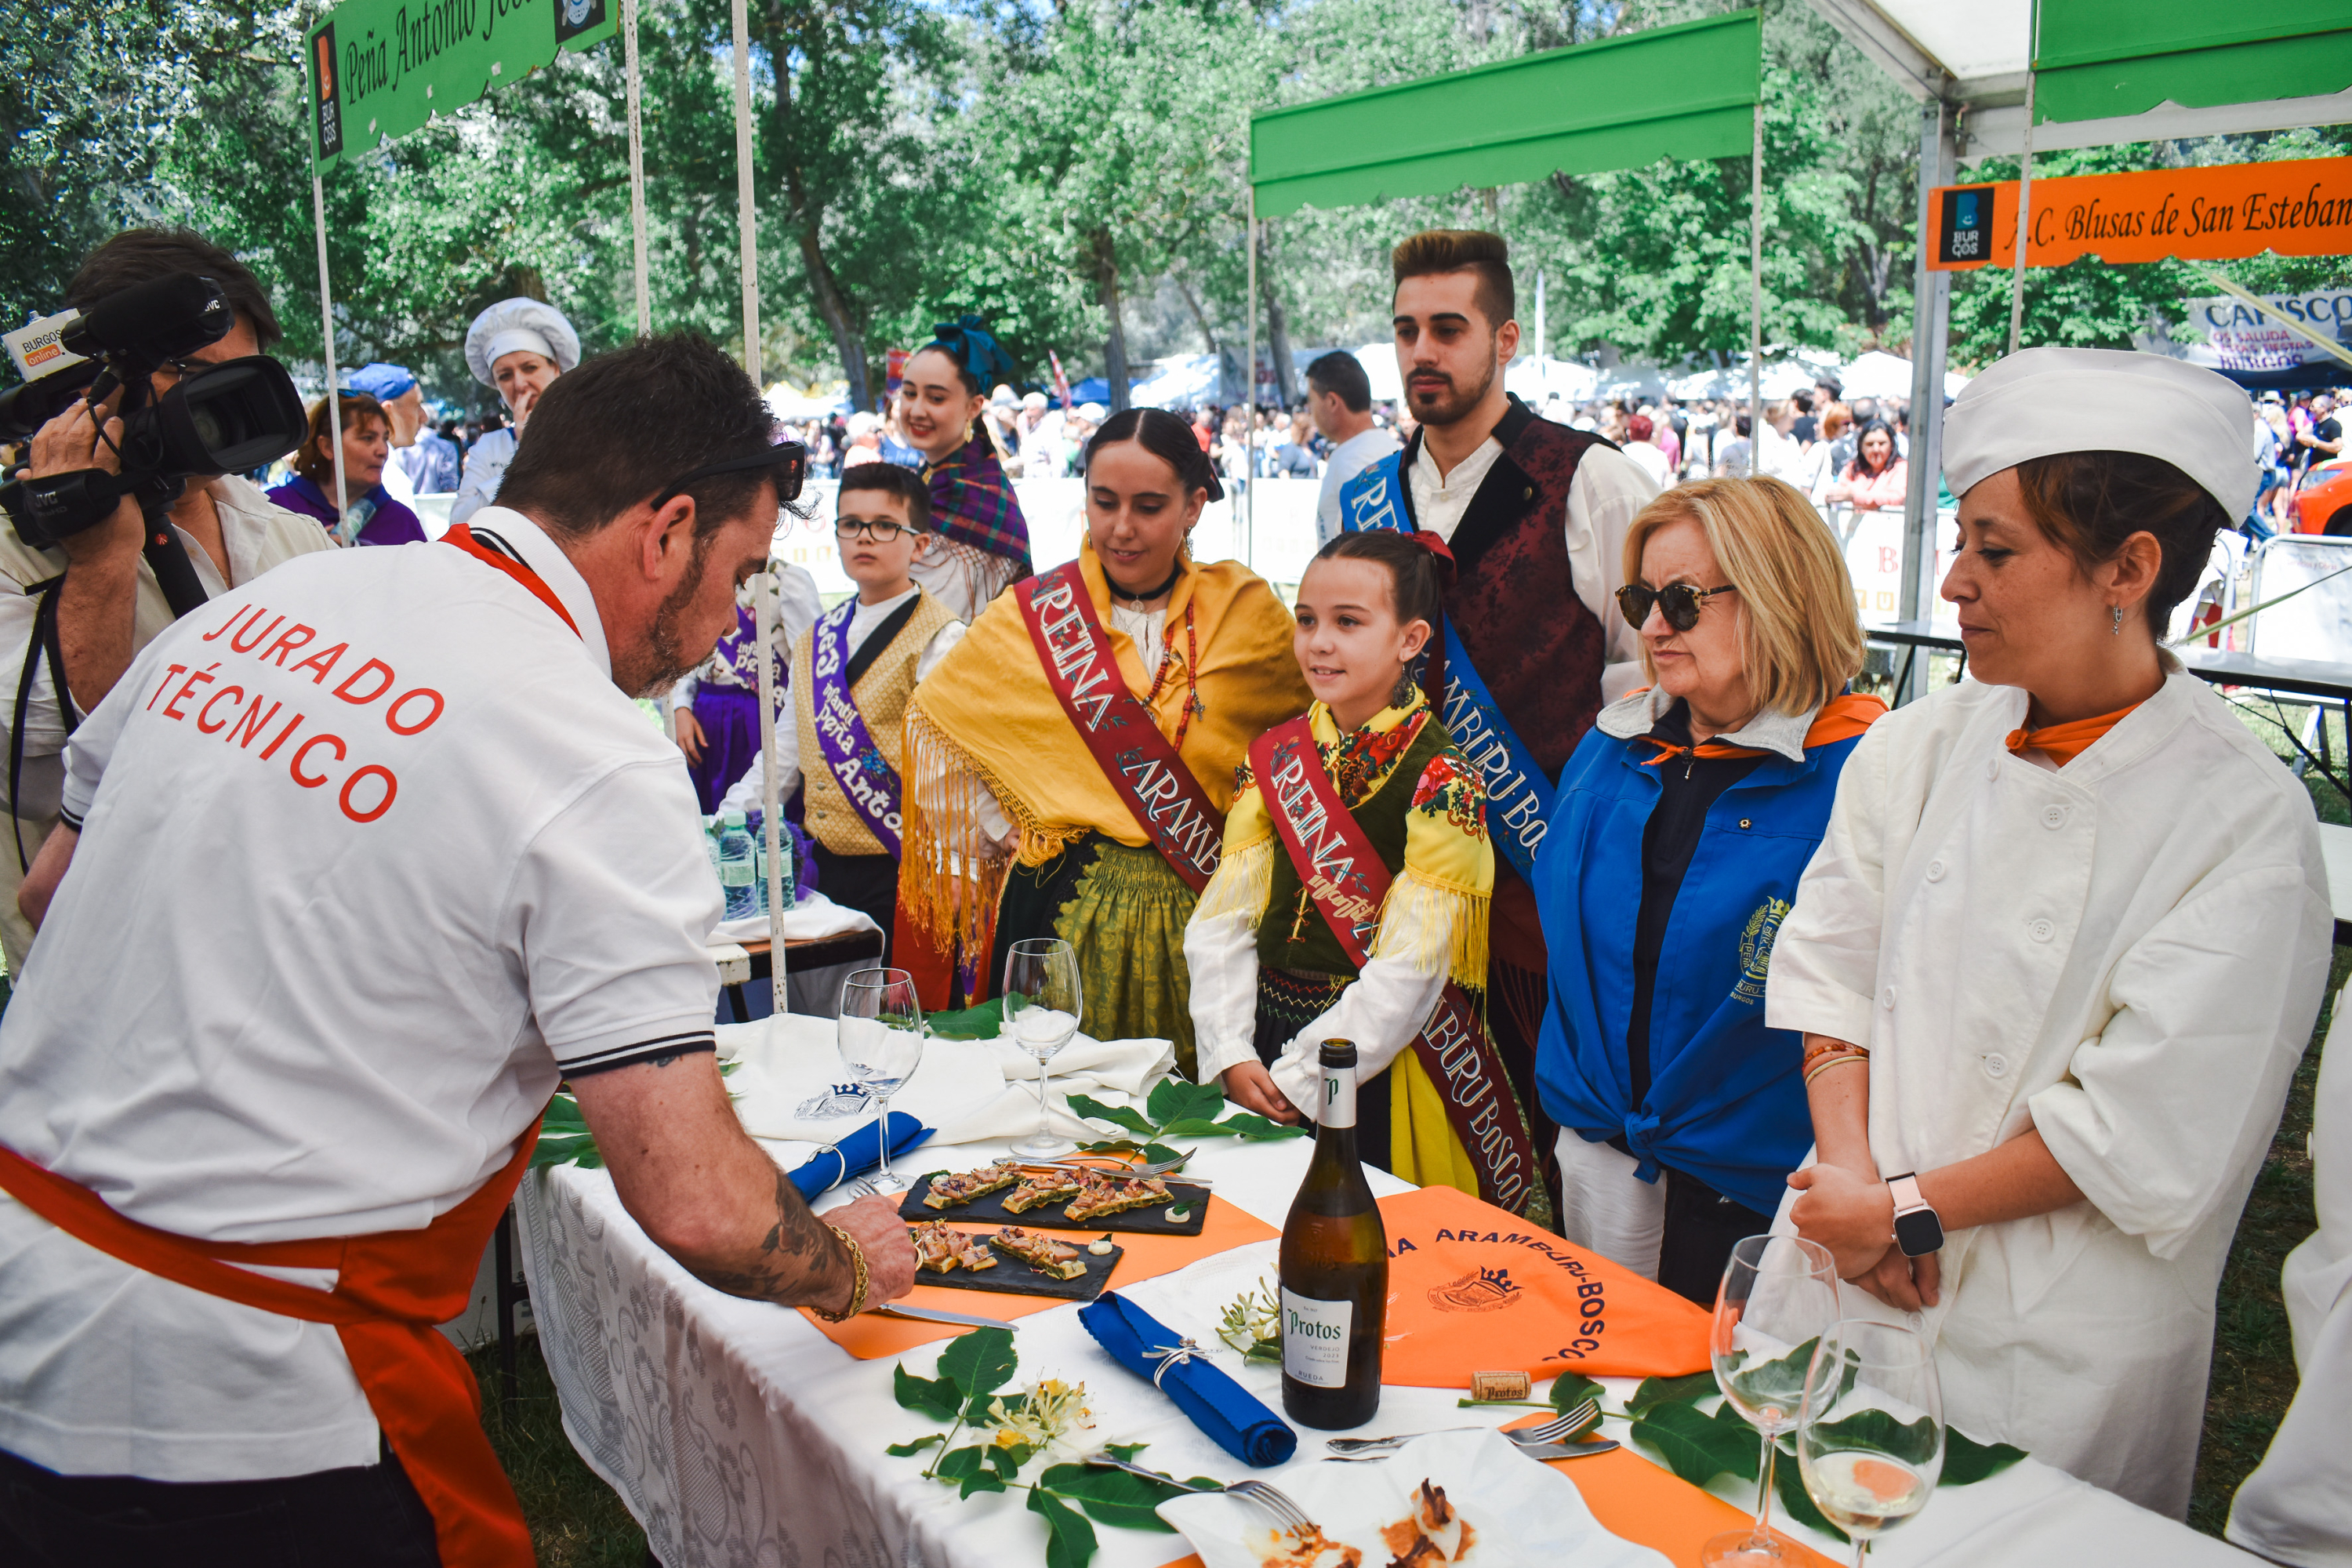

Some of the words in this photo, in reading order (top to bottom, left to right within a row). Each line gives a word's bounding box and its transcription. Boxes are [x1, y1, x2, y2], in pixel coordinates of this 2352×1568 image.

[345, 27, 389, 106] Peña
[2064, 198, 2146, 241] Blusas
[2151, 192, 2180, 236] de
[2183, 197, 2234, 238] San
[2242, 182, 2352, 232] Esteban
[22, 328, 61, 354] BURGOS
[29, 348, 59, 365] online
[34, 491, 59, 508] JVC
[201, 603, 445, 736] JURADO
[1029, 582, 1115, 733] REINA
[146, 661, 398, 823] TÉCNICO
[833, 757, 903, 840] Anto
[1271, 754, 1355, 884] REINA
[1730, 991, 1755, 1005] BURGOS
[1287, 1308, 1341, 1340] Protos
[1298, 1370, 1323, 1381] RUEDA
[1483, 1385, 1523, 1400] Protos
